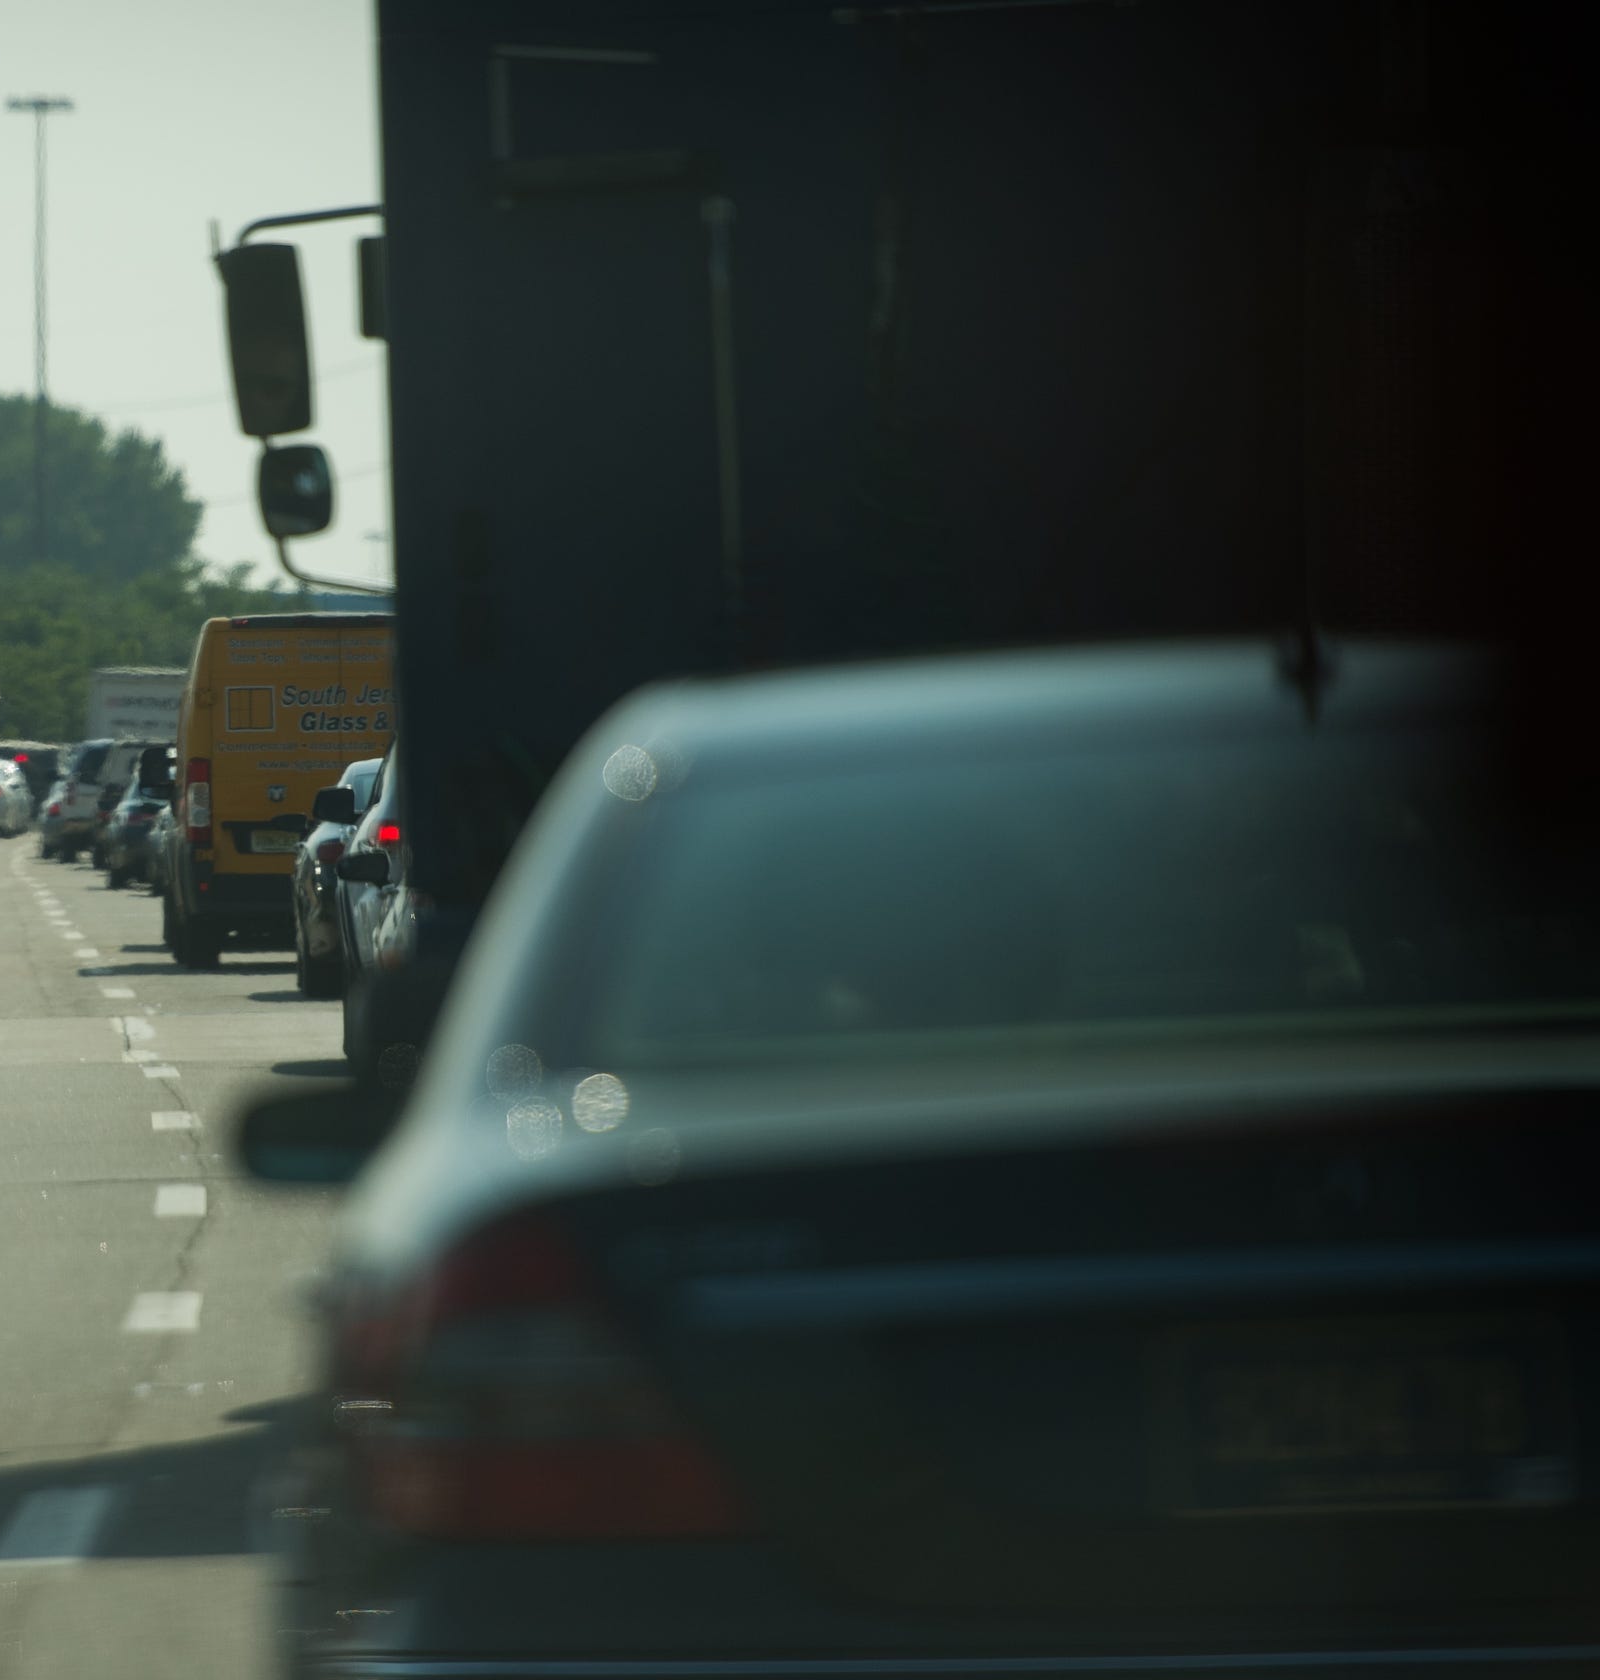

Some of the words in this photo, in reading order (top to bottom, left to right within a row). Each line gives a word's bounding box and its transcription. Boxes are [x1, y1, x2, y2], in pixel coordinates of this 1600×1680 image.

[281, 683, 346, 706] South
[300, 711, 369, 732] Glass
[373, 711, 389, 731] &
